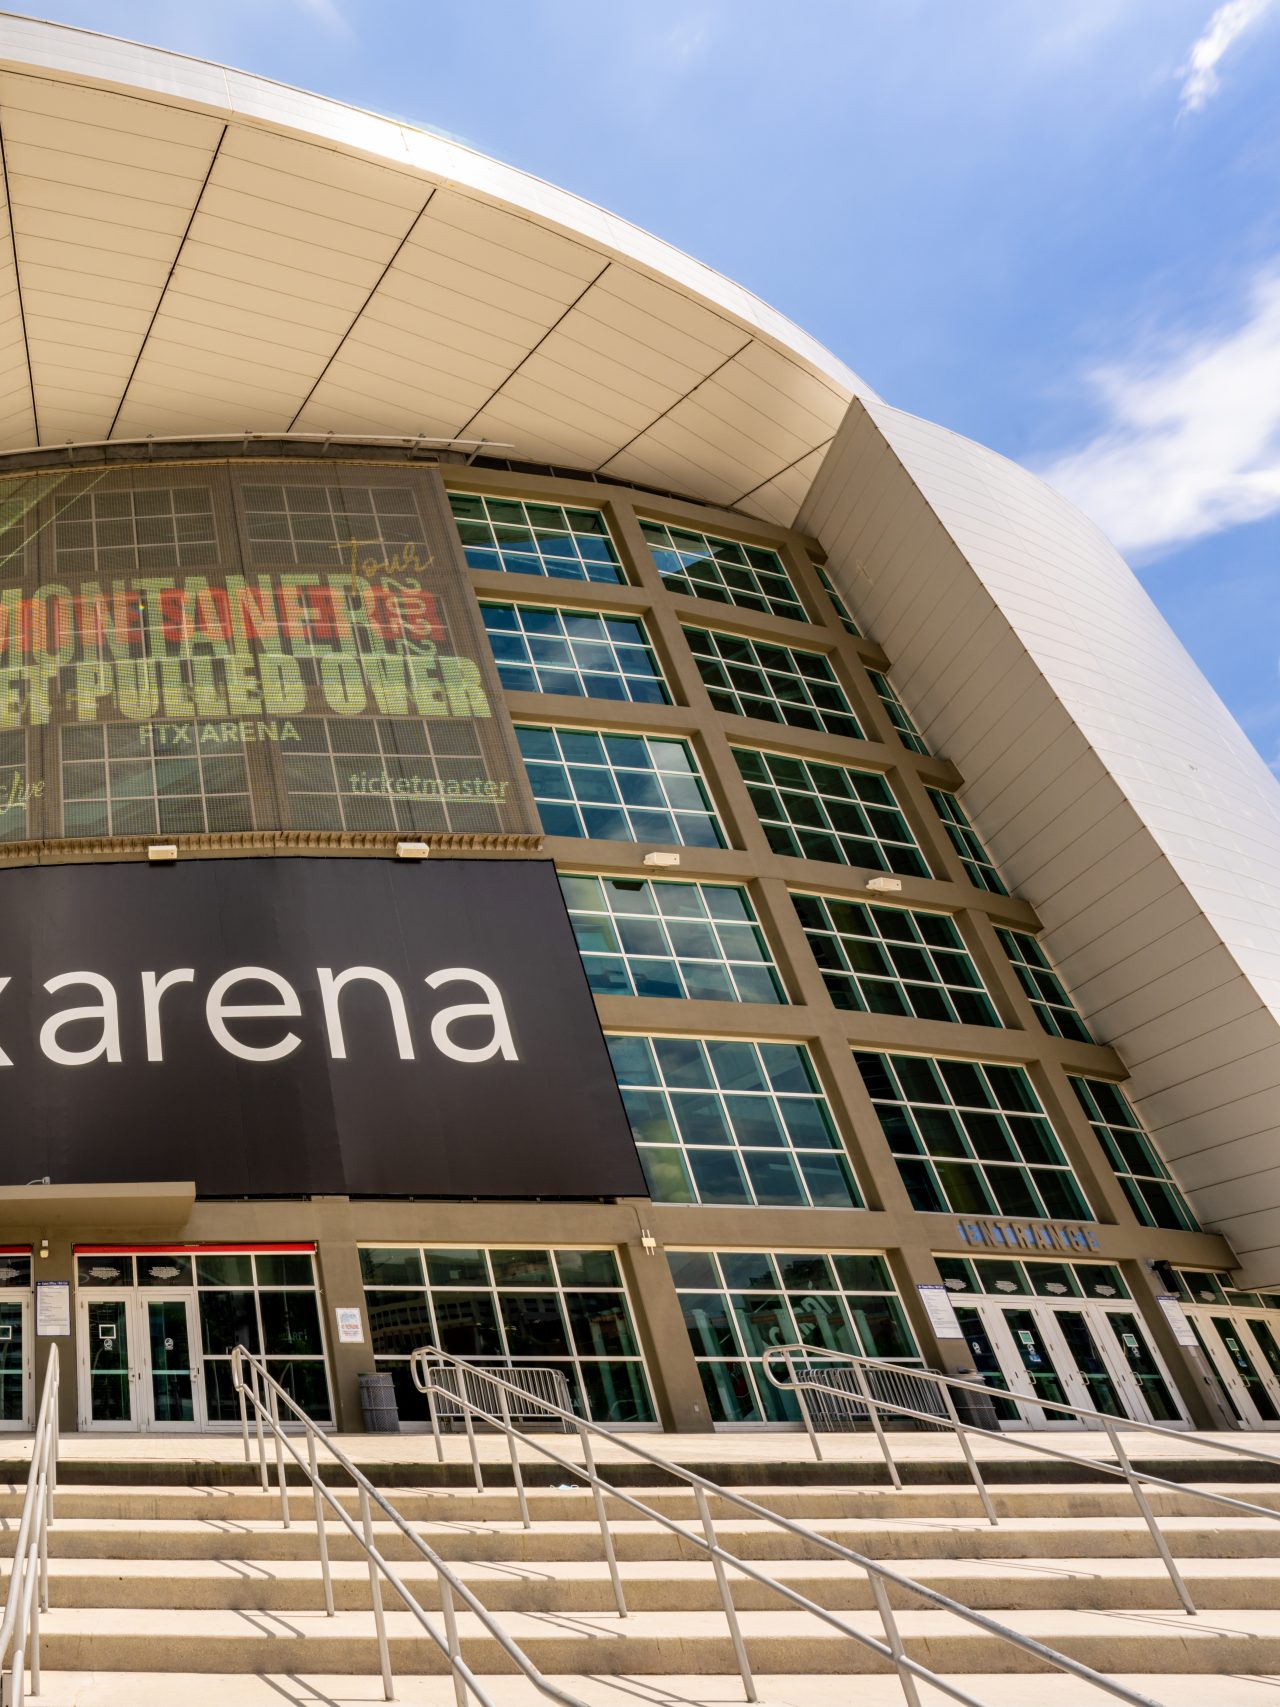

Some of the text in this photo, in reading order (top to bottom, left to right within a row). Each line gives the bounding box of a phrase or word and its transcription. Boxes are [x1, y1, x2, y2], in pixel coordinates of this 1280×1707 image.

[76, 654, 308, 722] PULLED
[320, 655, 493, 718] OVER
[138, 720, 303, 746] FTX ARENA
[349, 772, 510, 800] ticketmaster
[38, 965, 520, 1064] arena
[958, 1218, 1102, 1253] ENTRANCE
